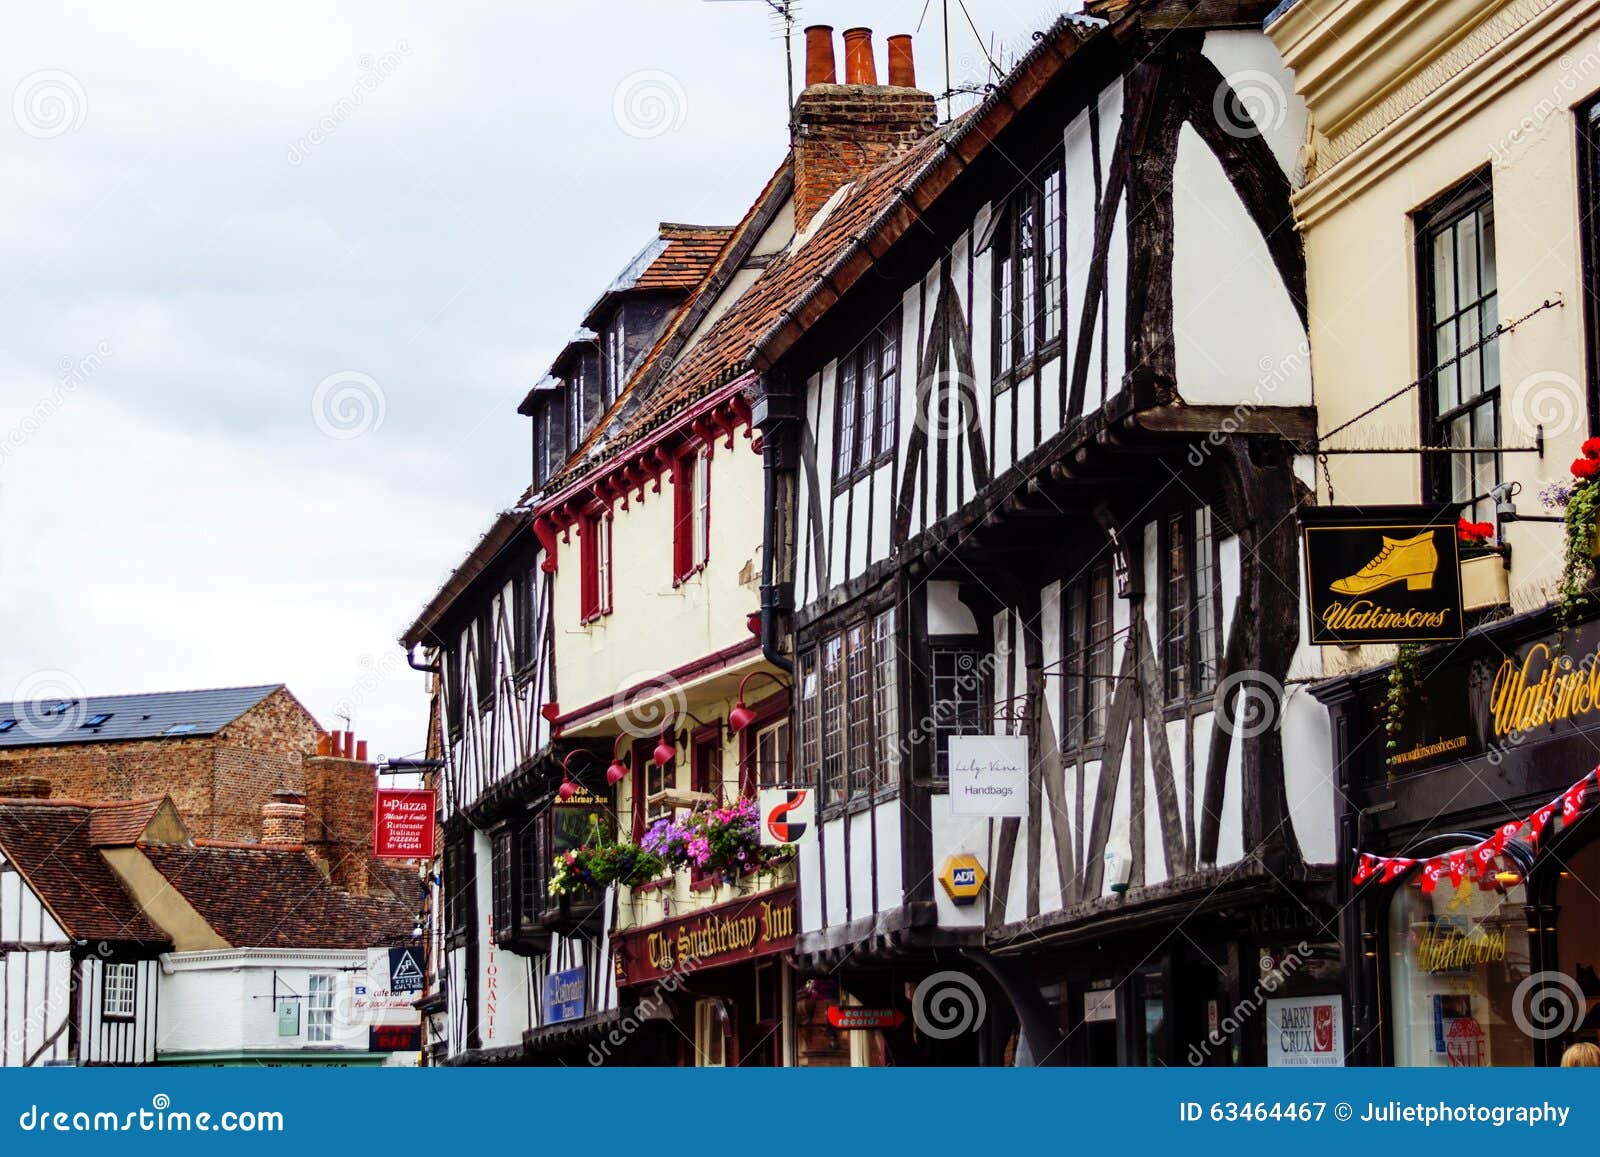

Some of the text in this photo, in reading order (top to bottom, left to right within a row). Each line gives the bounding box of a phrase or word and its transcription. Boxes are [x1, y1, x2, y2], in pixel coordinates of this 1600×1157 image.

[1322, 600, 1450, 630] Watkinsons
[1490, 643, 1600, 737] Watkins
[989, 760, 1021, 772] Vine
[965, 785, 1013, 796] Handbags
[954, 870, 975, 883] ADT
[648, 929, 673, 968] The
[760, 899, 793, 942] Inn
[1417, 914, 1511, 972] Watkinsons
[1281, 1006, 1312, 1029] BARRY
[1280, 1030, 1313, 1052] CRUX
